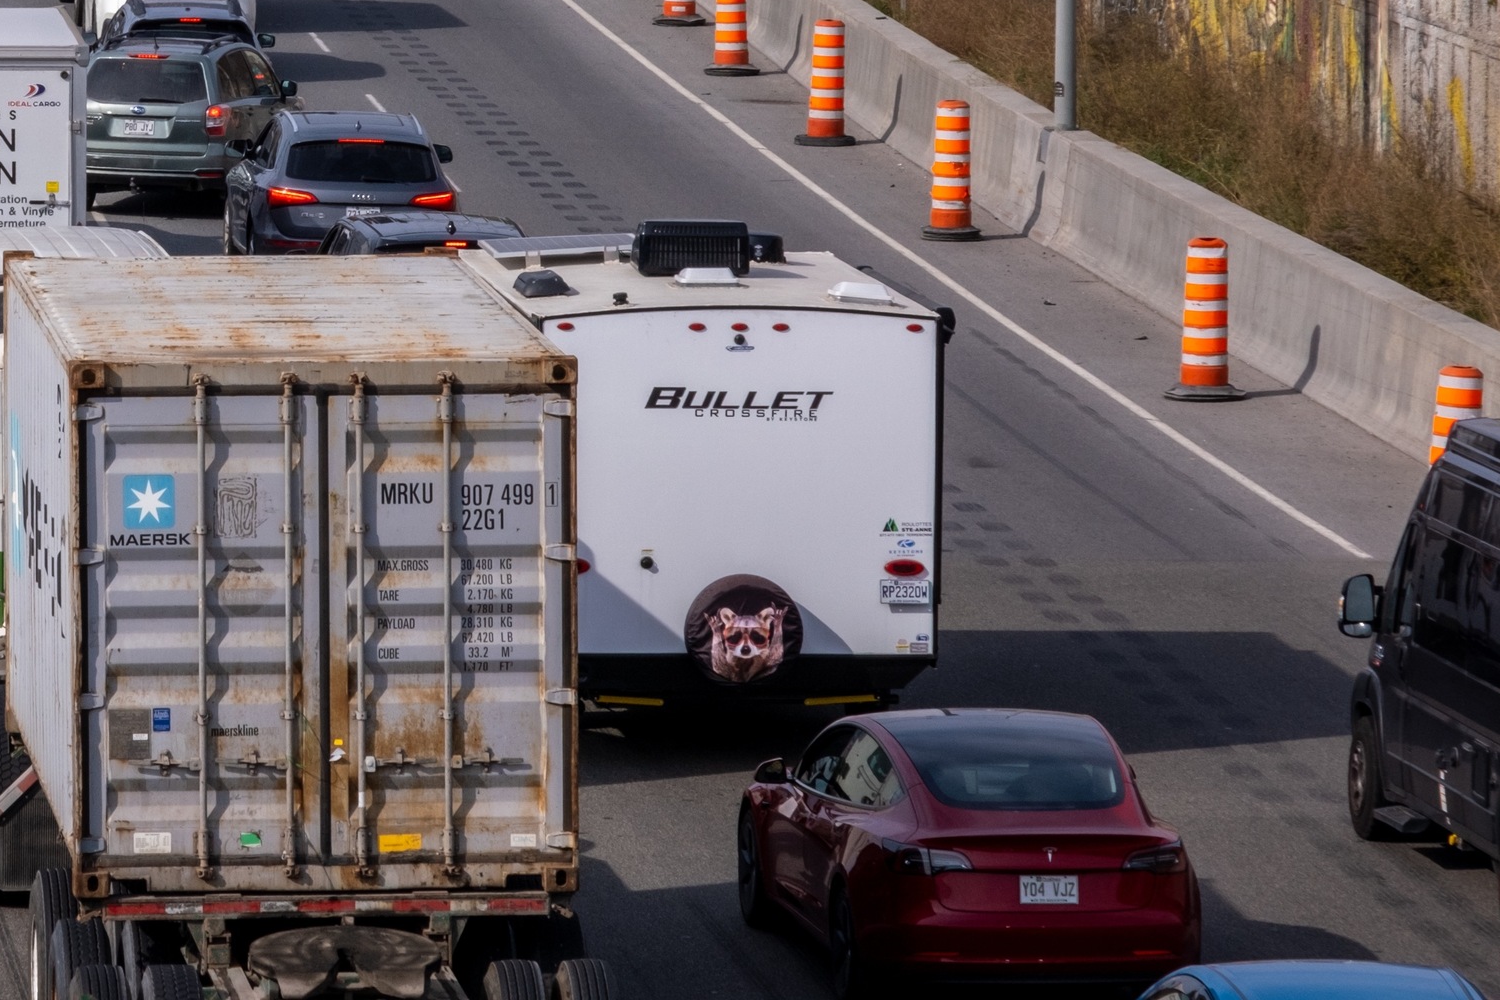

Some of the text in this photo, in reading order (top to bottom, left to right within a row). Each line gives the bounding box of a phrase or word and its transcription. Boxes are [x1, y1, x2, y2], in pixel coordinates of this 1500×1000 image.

[9, 207, 16, 216] &
[22, 207, 54, 218] Vinyle
[695, 409, 818, 418] CROSSFIRE
[381, 483, 434, 504] MRKU
[461, 484, 494, 506] 907
[501, 484, 534, 505] 499
[462, 509, 505, 531] 22G1
[110, 533, 191, 546] MAERSK
[377, 558, 512, 571] MAX.GROSS 30.480 KG
[461, 573, 512, 586] 67.200 LB
[379, 588, 513, 601] TARE 2.170 KG
[882, 586, 928, 598] RP2320W
[467, 603, 513, 613] 4.780 LB
[377, 616, 513, 629] PAYLOAD 28.310 KG
[462, 631, 513, 643] 62.420 LB
[378, 648, 400, 659] CUBE
[468, 647, 488, 658] 33.2
[463, 661, 488, 672] 1.170
[1022, 882, 1076, 897] Y04 VJZ
